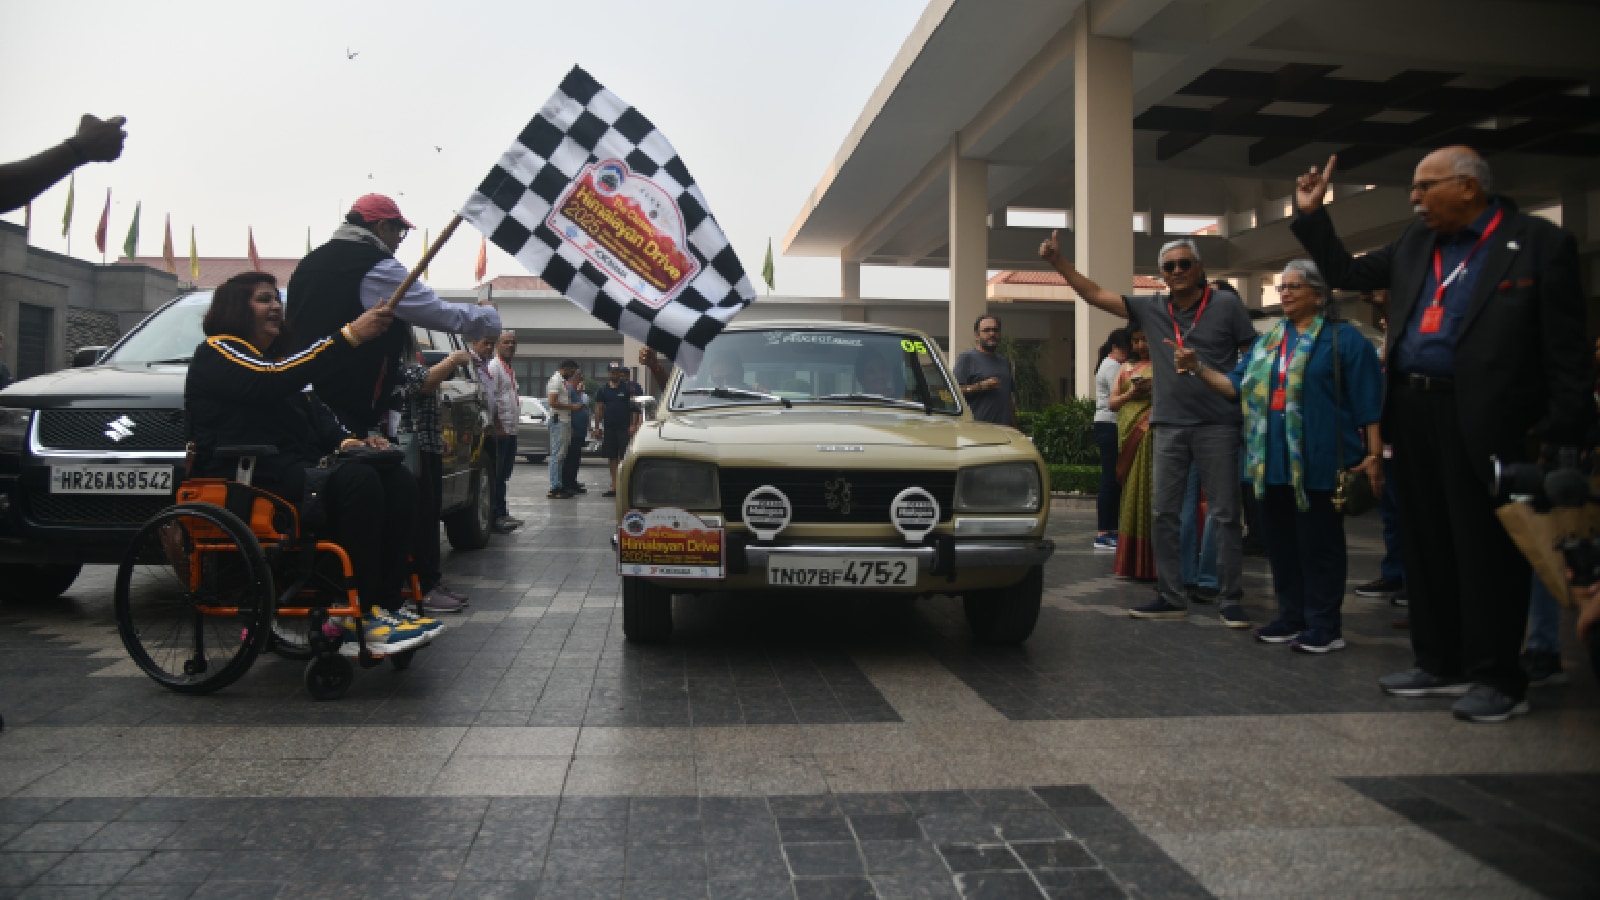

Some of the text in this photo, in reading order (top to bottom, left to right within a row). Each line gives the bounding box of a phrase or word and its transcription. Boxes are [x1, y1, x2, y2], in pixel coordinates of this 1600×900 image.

[563, 199, 602, 236] 2025
[576, 184, 645, 248] Himalayan
[643, 240, 681, 281] Drive
[61, 471, 171, 490] HR26AS8542
[621, 537, 720, 554] Himalayan Drive
[770, 560, 908, 586] TN07BF4752
